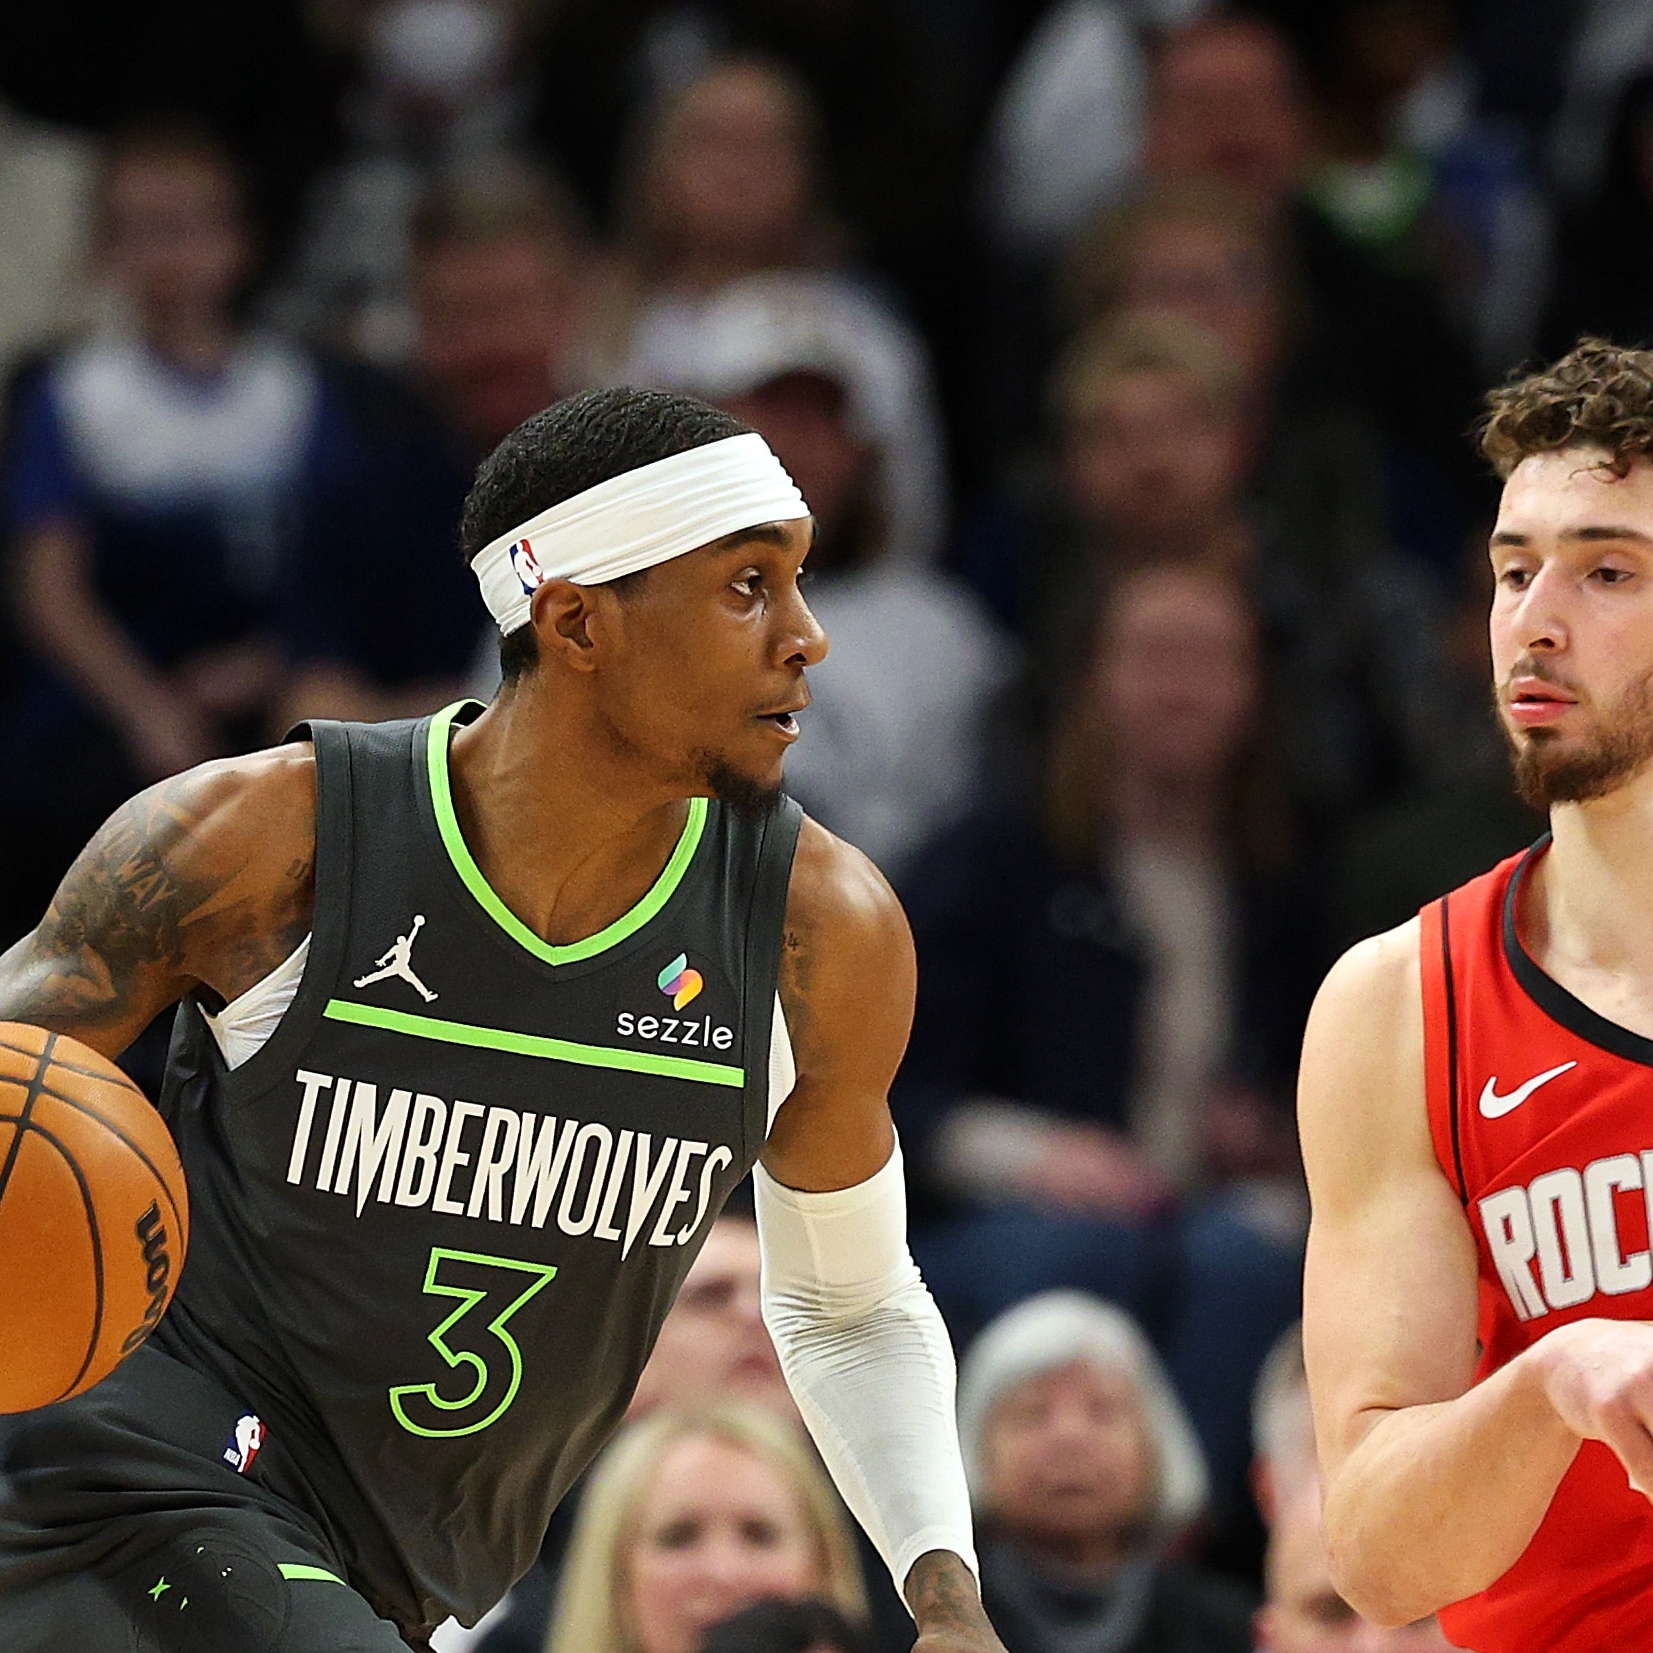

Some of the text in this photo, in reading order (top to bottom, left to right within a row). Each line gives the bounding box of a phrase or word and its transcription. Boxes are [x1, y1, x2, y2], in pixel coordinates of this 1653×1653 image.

[616, 1012, 734, 1050] sezzle
[286, 1069, 734, 1262] TIMBERWOLVES
[389, 1246, 559, 1438] 3
[223, 1448, 241, 1466] NBA
